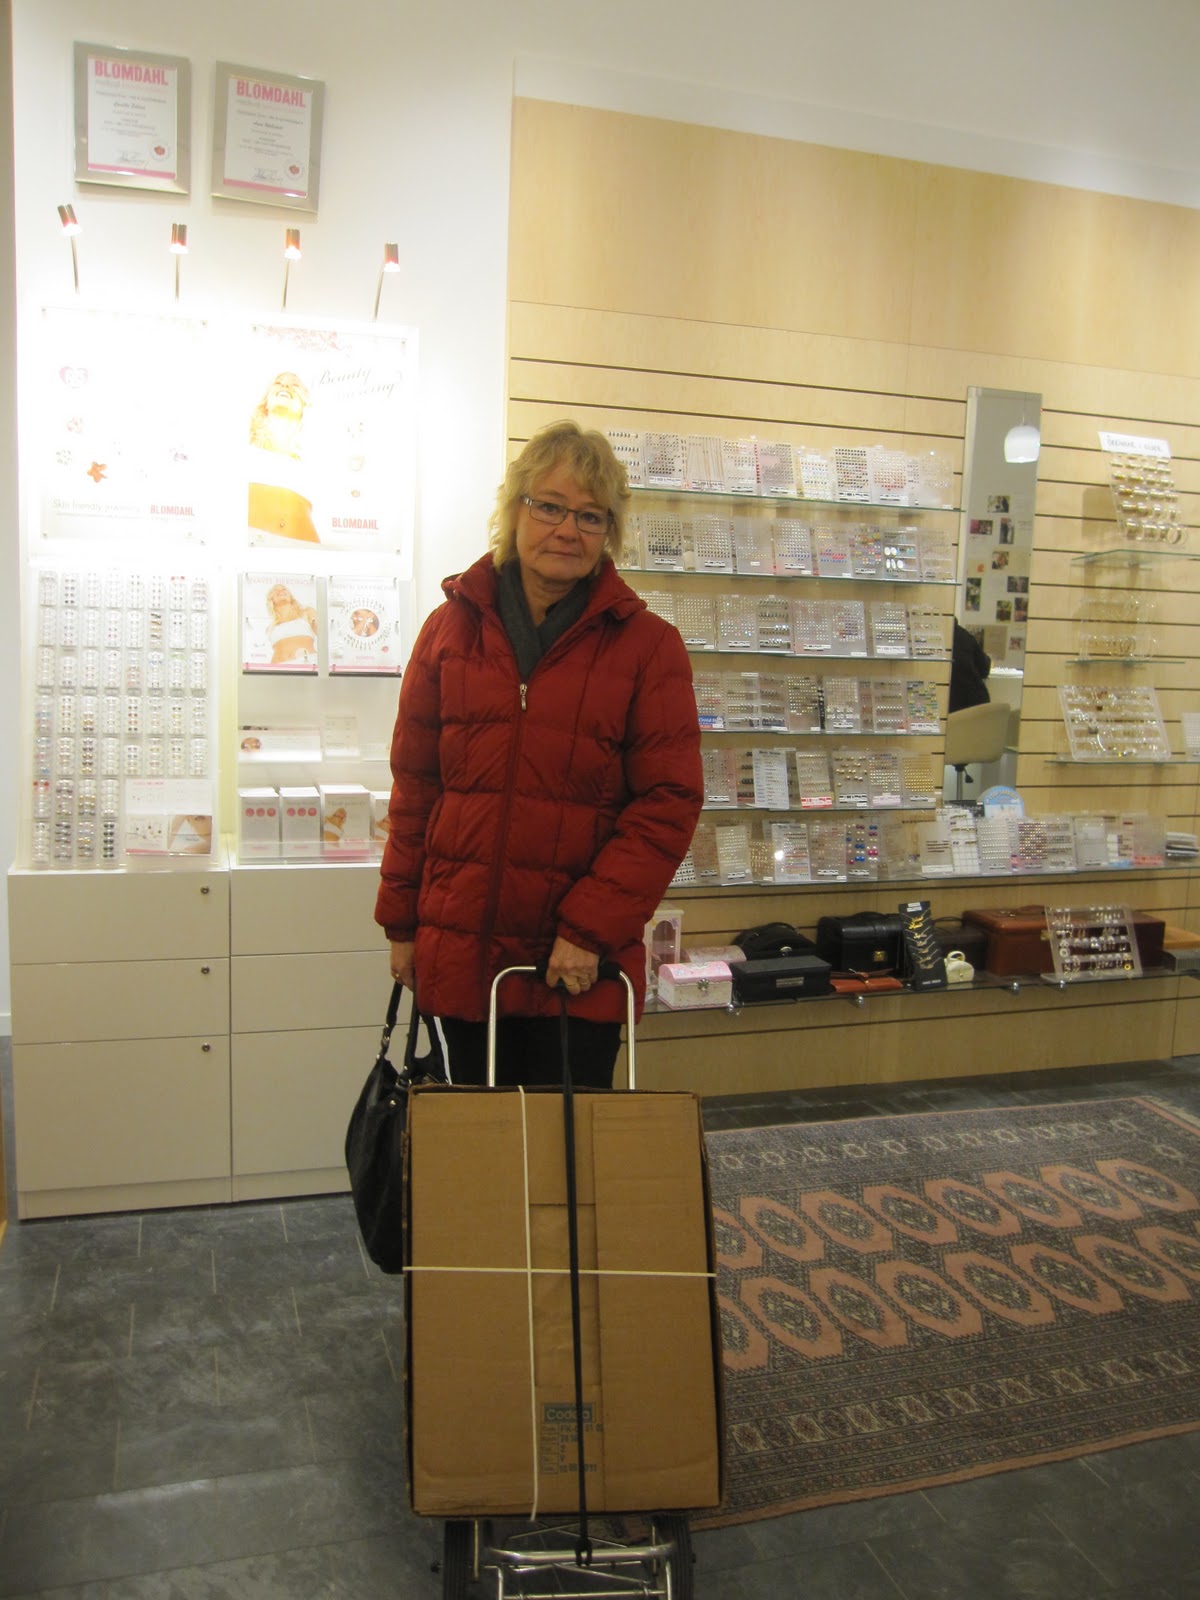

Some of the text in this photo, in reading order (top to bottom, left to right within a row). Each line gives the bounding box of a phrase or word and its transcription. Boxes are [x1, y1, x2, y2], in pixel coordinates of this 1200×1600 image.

[94, 60, 169, 86] BLOMDAHL
[236, 80, 306, 109] BLOMDAHL
[150, 504, 195, 517] BLOMDAHL
[331, 517, 379, 531] BLOMDAHL
